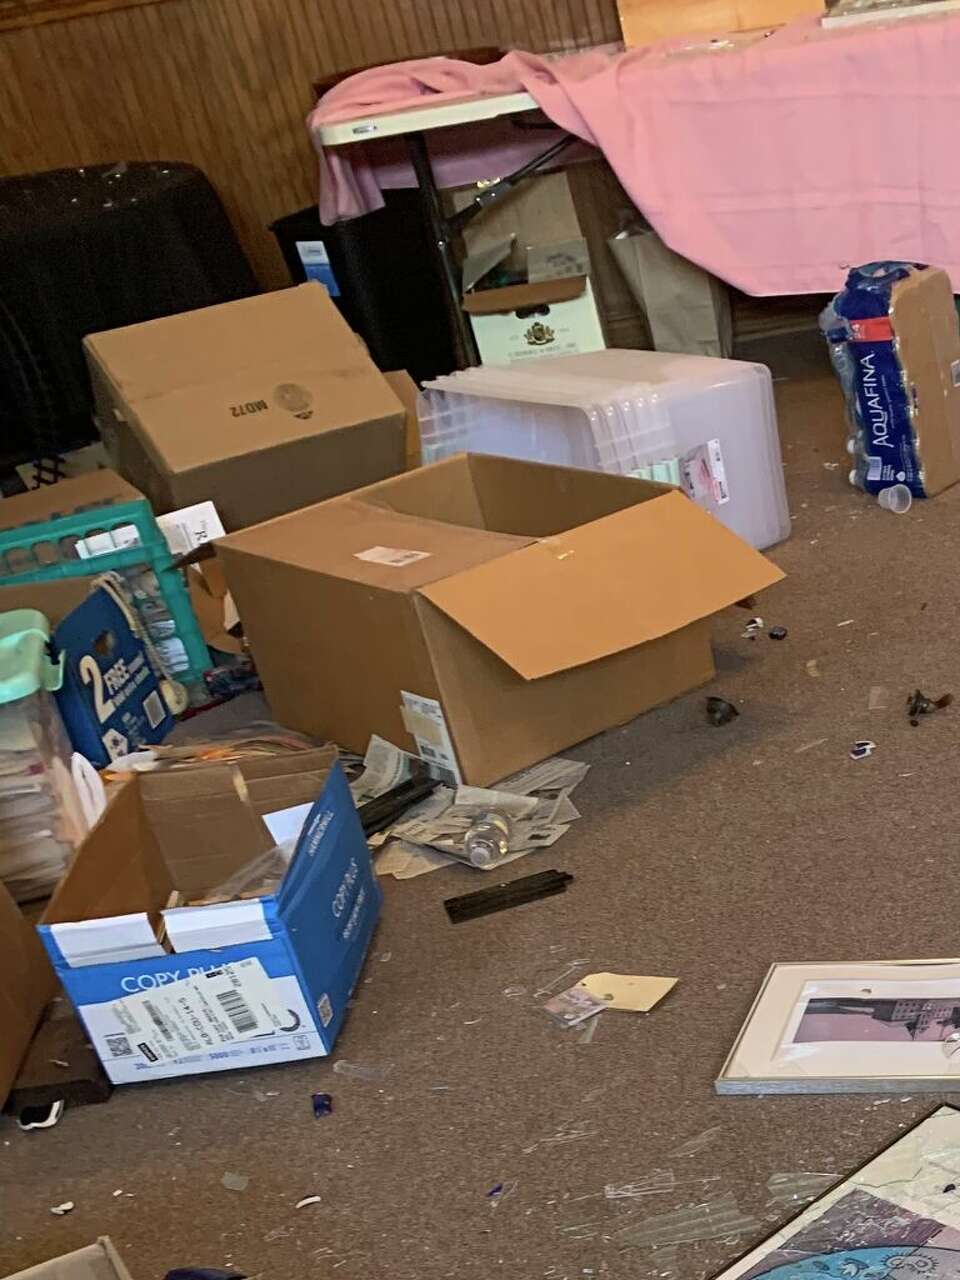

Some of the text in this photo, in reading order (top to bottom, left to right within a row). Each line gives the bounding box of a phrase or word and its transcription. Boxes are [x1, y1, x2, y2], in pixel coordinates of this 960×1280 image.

[860, 352, 895, 448] AQUAFINA
[79, 655, 117, 724] 2
[120, 969, 181, 993] COPY
